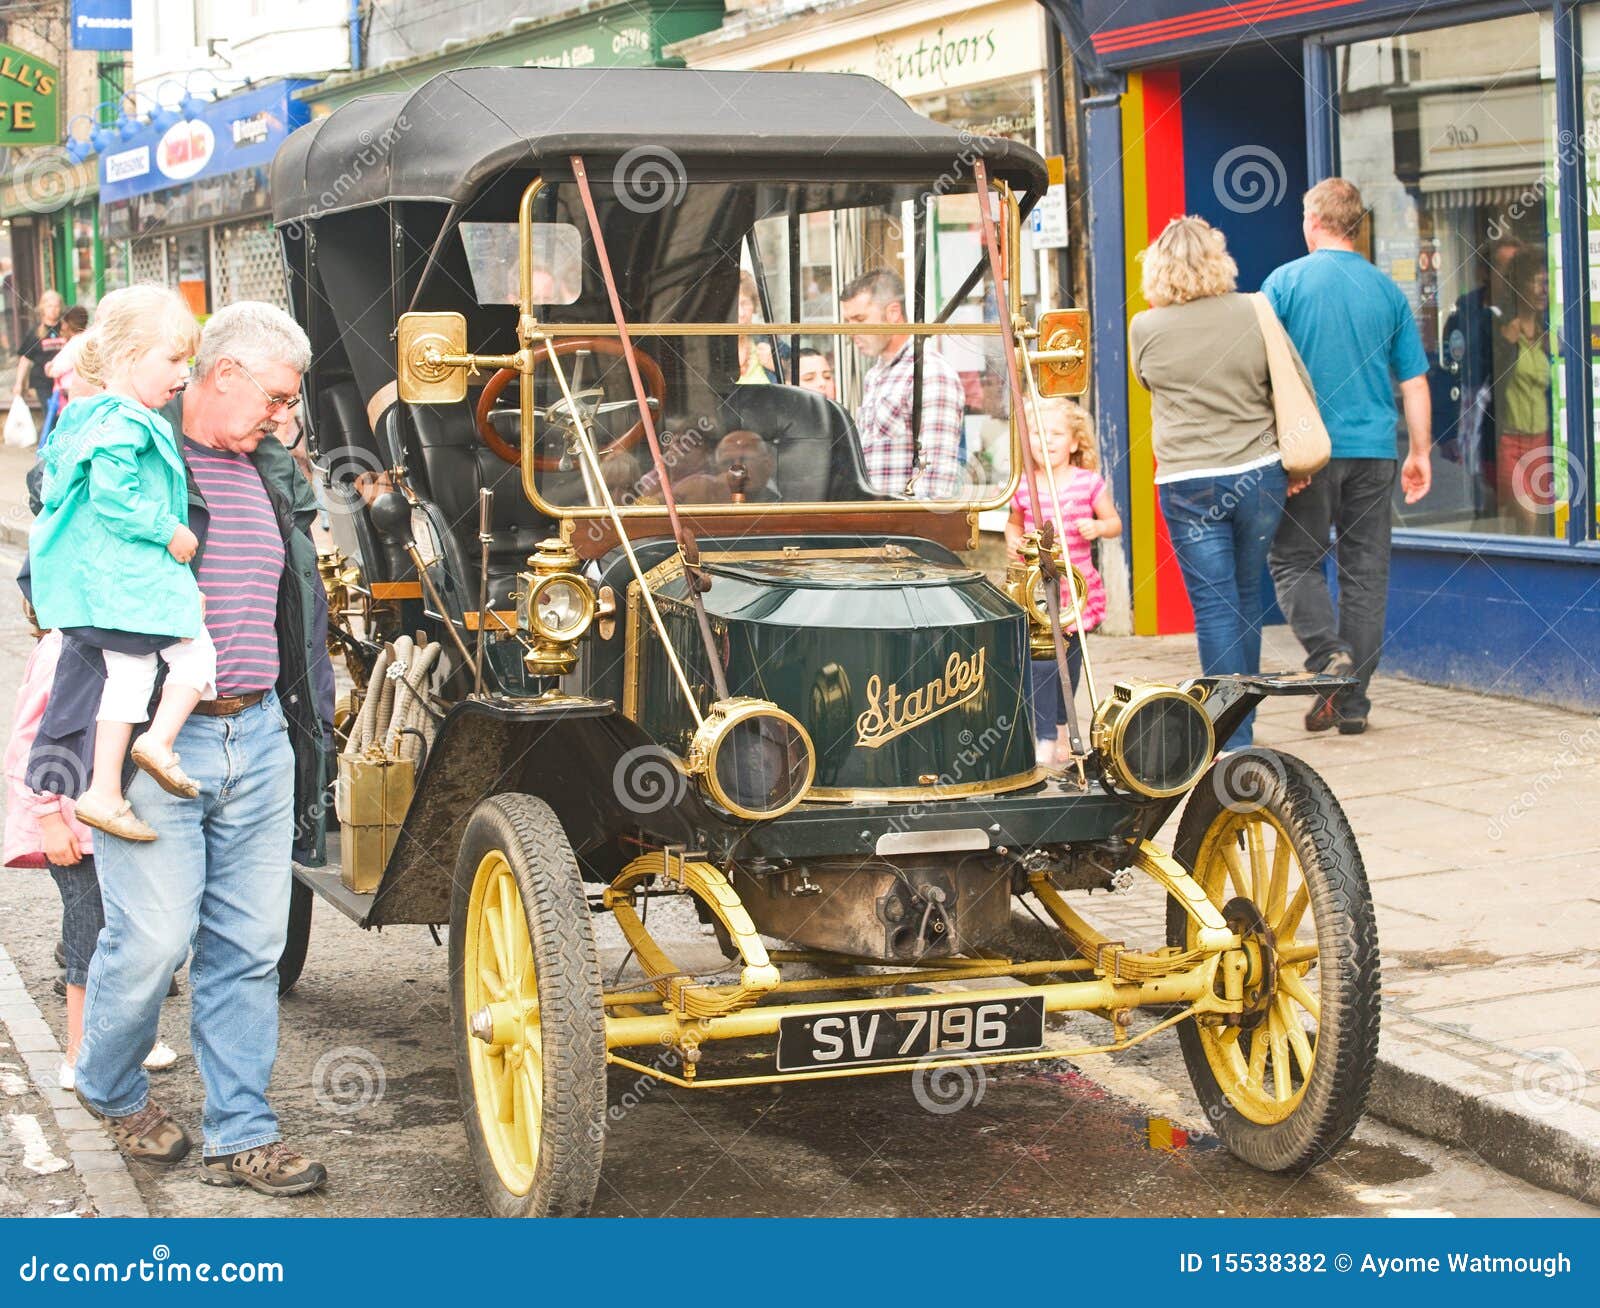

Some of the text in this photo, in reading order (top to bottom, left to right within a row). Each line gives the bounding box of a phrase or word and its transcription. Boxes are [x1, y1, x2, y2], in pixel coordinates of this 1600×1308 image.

[854, 646, 985, 748] Stanley
[812, 1003, 1008, 1061] SV 7196
